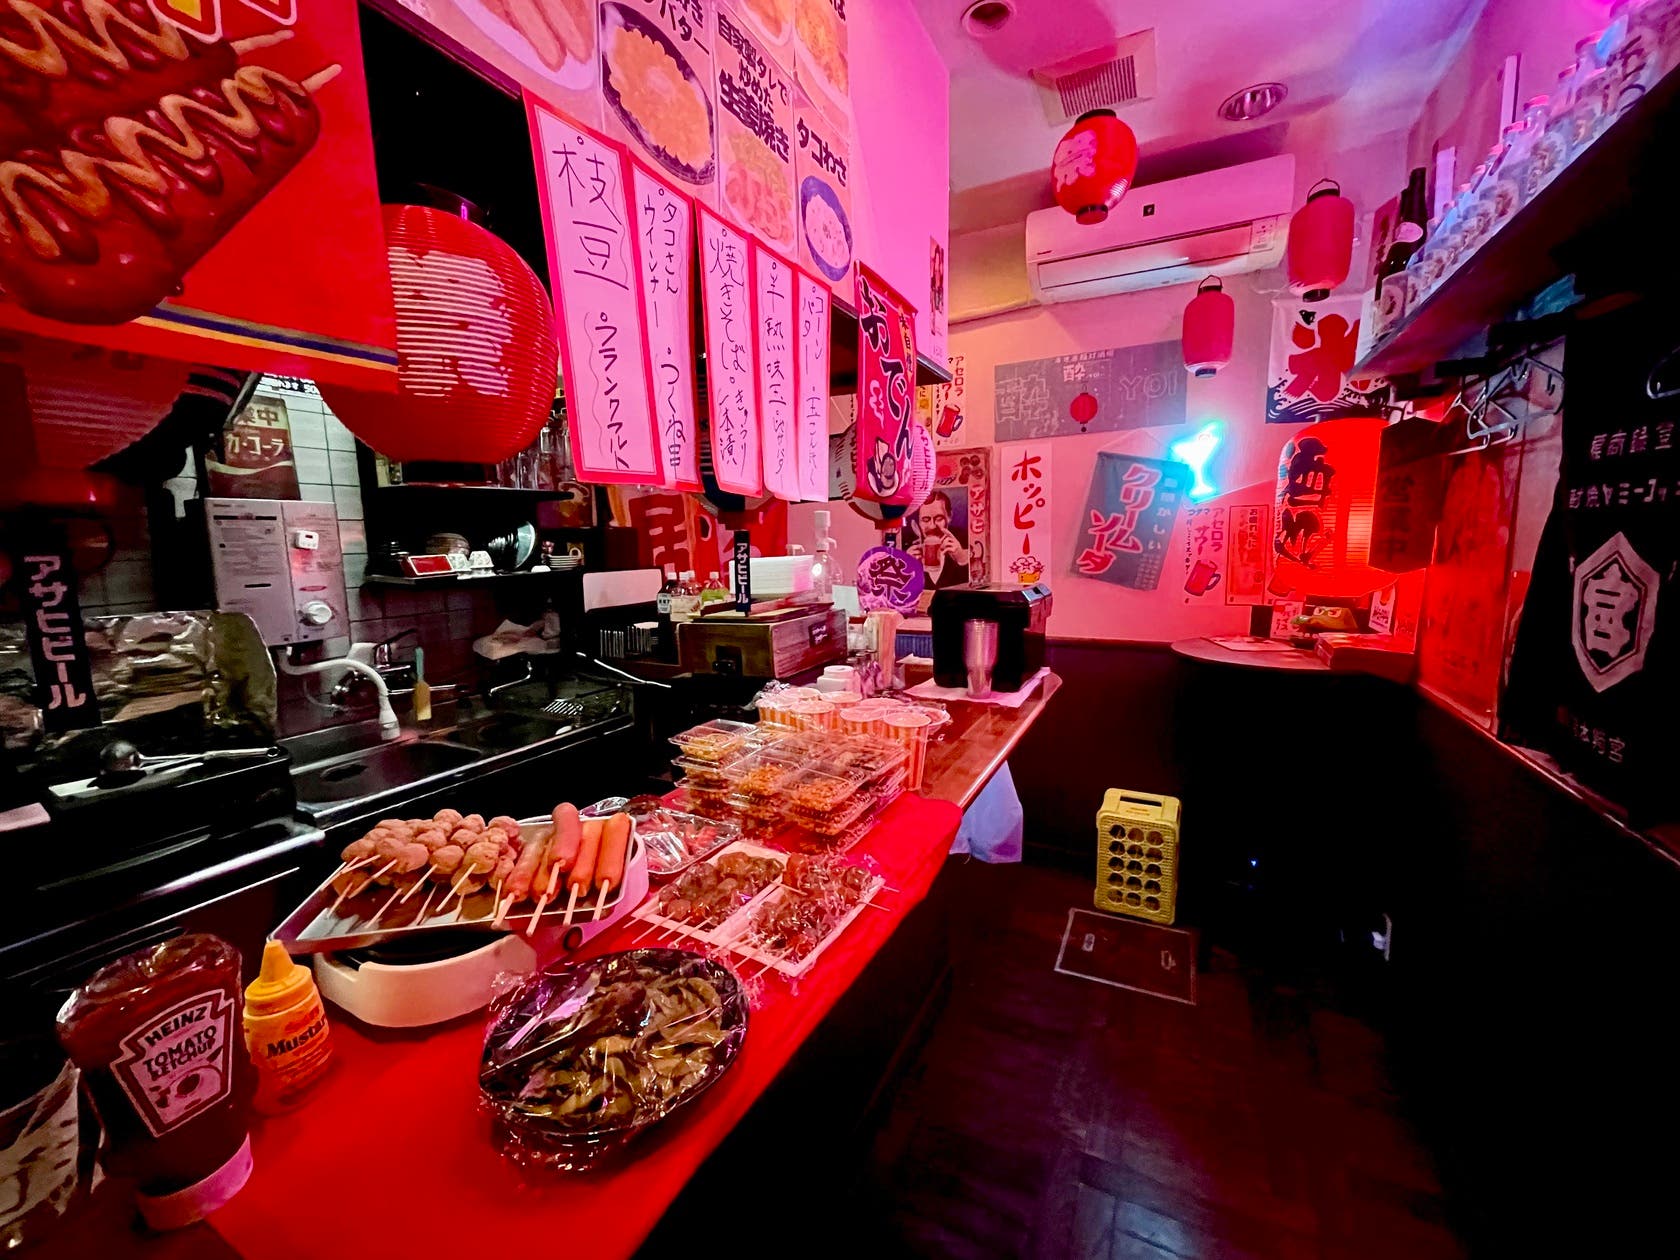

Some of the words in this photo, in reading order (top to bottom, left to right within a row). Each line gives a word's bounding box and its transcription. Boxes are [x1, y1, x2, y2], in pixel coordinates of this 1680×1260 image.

[717, 11, 787, 106] 自家製タレで
[718, 68, 789, 164] 生姜焼き
[796, 117, 847, 187] タコわさ
[551, 142, 629, 291] 枝豆
[662, 201, 680, 294] タコさん
[708, 237, 747, 374] 焼きそば
[859, 276, 915, 462] おでん
[953, 356, 964, 397] アセロラ
[1119, 371, 1177, 402] YOI
[1012, 450, 1045, 554] ホッピー
[1075, 509, 1124, 575] ソーダ
[1114, 463, 1163, 554] クリーム
[1211, 507, 1225, 552] アセロラ
[736, 542, 749, 604] アサヒビール
[23, 555, 87, 711] アサヒビール
[143, 1024, 218, 1073] TOMATO
[144, 1005, 209, 1047] HEINZ
